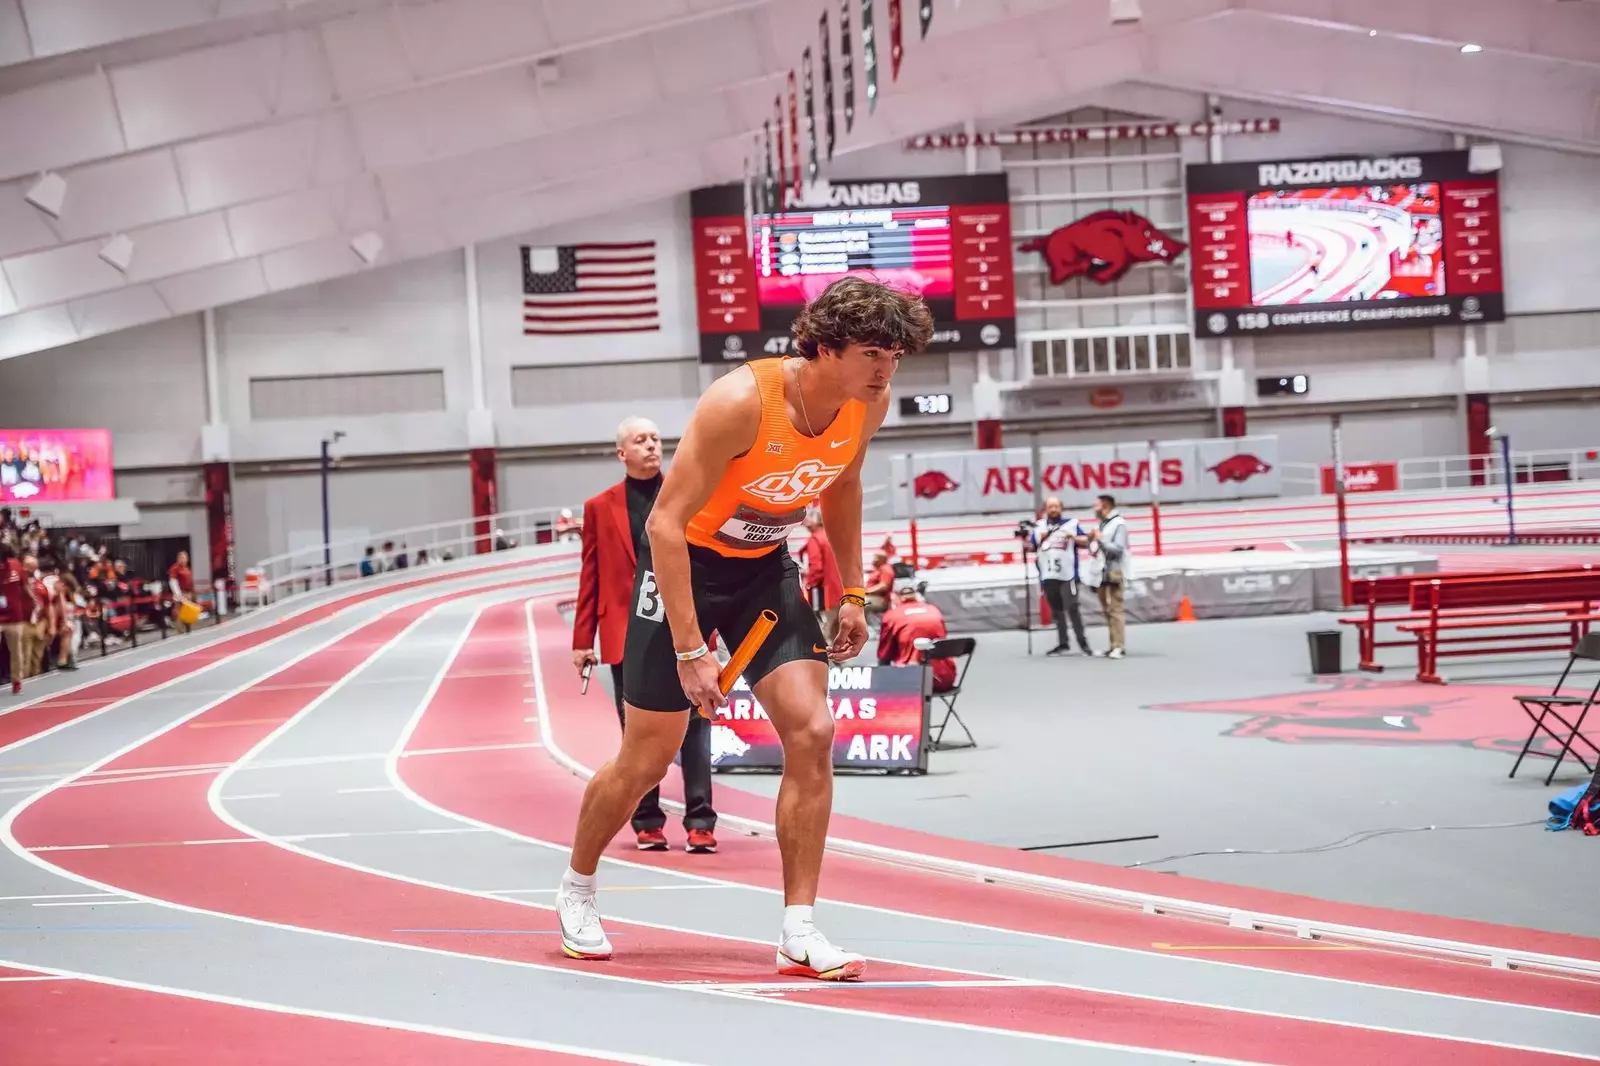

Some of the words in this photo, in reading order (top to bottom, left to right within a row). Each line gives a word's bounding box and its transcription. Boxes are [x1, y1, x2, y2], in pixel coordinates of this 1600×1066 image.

[1258, 156, 1422, 186] RAZORBACKS
[1272, 309, 1350, 326] CONFERENCE
[1352, 303, 1451, 321] CHAMPIONSHIPS
[745, 462, 844, 502] OSU
[743, 523, 787, 535] TRISTON
[744, 533, 773, 541] READ
[641, 575, 659, 617] 3
[1222, 574, 1273, 594] UCS
[846, 735, 914, 761] ARK
